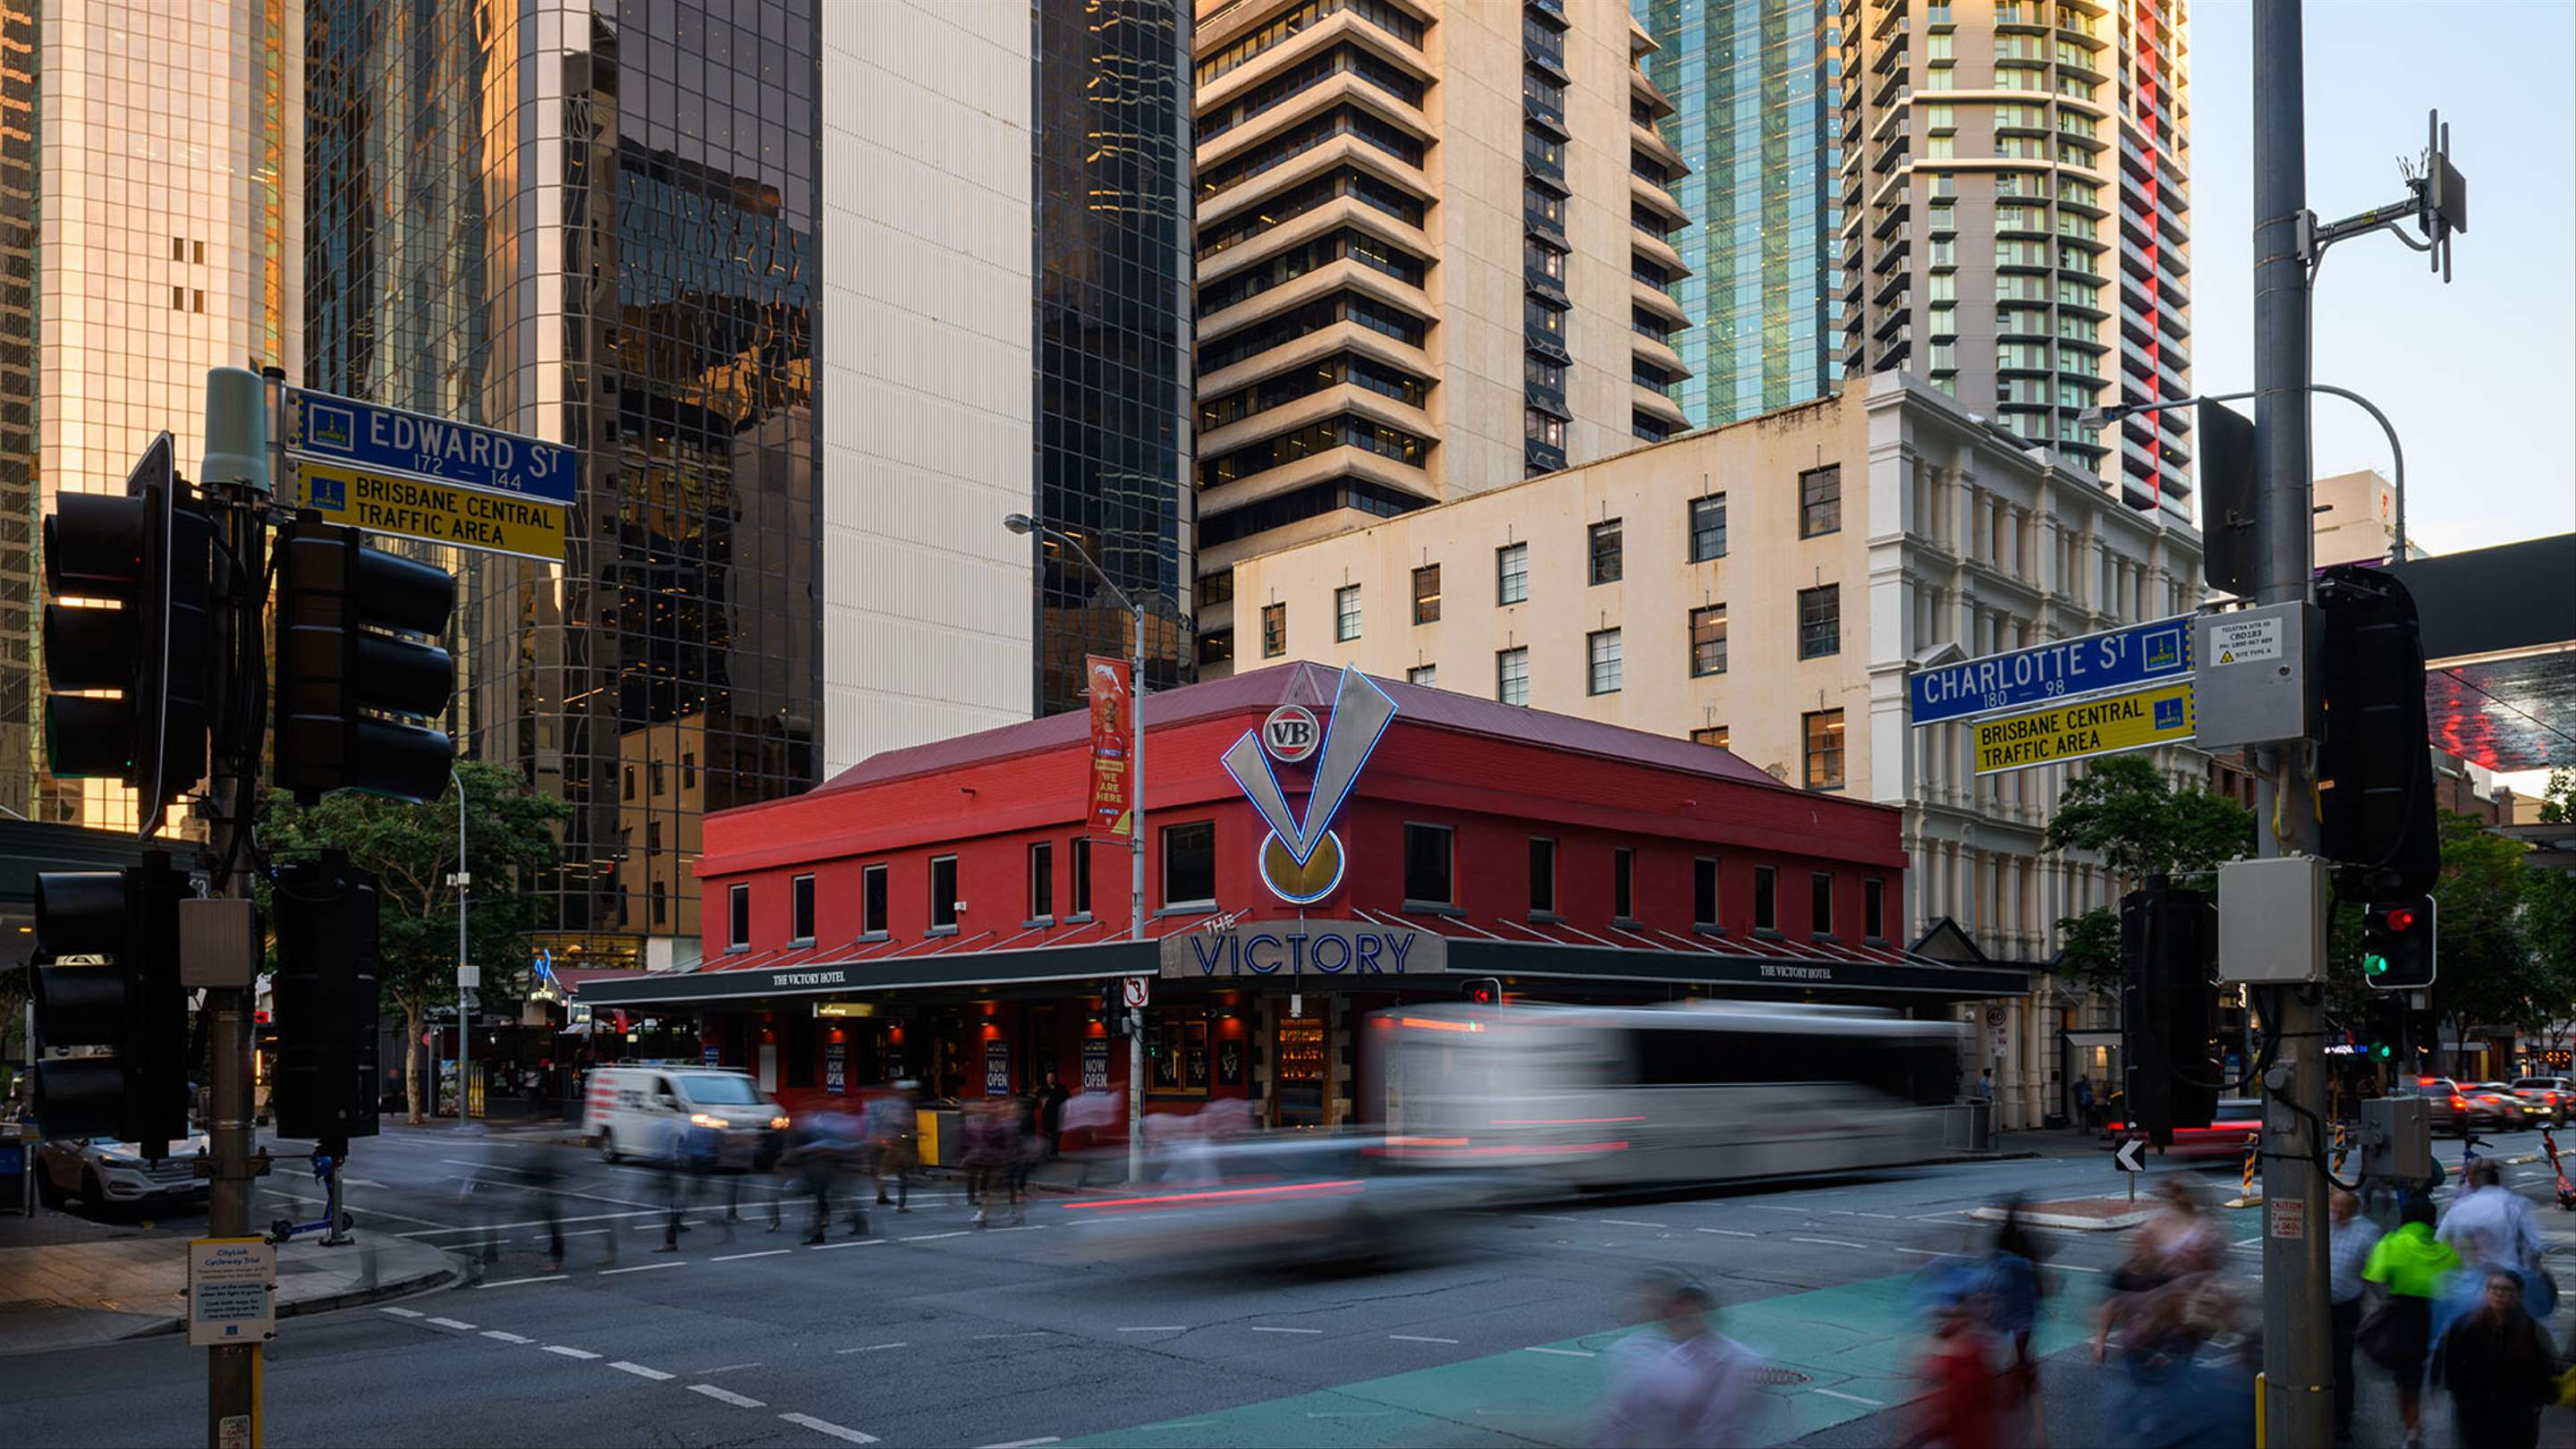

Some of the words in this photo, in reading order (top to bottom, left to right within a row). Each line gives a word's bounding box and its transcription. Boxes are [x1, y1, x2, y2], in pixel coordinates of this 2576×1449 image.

[370, 411, 514, 471] EDWARD
[528, 447, 562, 479] ST
[414, 453, 444, 476] 172
[491, 470, 522, 491] 144
[357, 478, 456, 515] BRISBANE
[467, 496, 555, 530] CENTRAL
[357, 502, 444, 536] TRAFFIC
[451, 519, 505, 546] AREA
[1925, 642, 2087, 704] CHARLOTTE
[2099, 633, 2129, 670] ST
[1983, 690, 2008, 709] 180
[2045, 679, 2065, 697] 98
[1981, 716, 2059, 746] BRISBANE
[2067, 699, 2144, 730] CENTRAL
[1271, 720, 1310, 746] VB
[1983, 739, 2050, 767] TRAFFIC
[2056, 730, 2101, 755] AREA
[1102, 773, 1117, 782] WE
[1100, 783, 1119, 792] ARE
[1097, 792, 1123, 803] HERE
[1203, 913, 1237, 936] THE
[1190, 933, 1416, 975] VICTORY
[773, 974, 787, 986] THE
[788, 972, 820, 985] VICTORY
[820, 970, 845, 983] HOTEL
[1759, 965, 1775, 977] THE
[1775, 966, 1808, 979] VICTORY
[1808, 968, 1832, 979] HOTEL
[827, 1061, 843, 1072] NOW
[988, 1060, 1006, 1072] NOW
[1086, 1059, 1106, 1072] NOW
[826, 1072, 844, 1085] OPEN
[987, 1072, 1008, 1087] OPEN
[1084, 1072, 1107, 1088] OPEN
